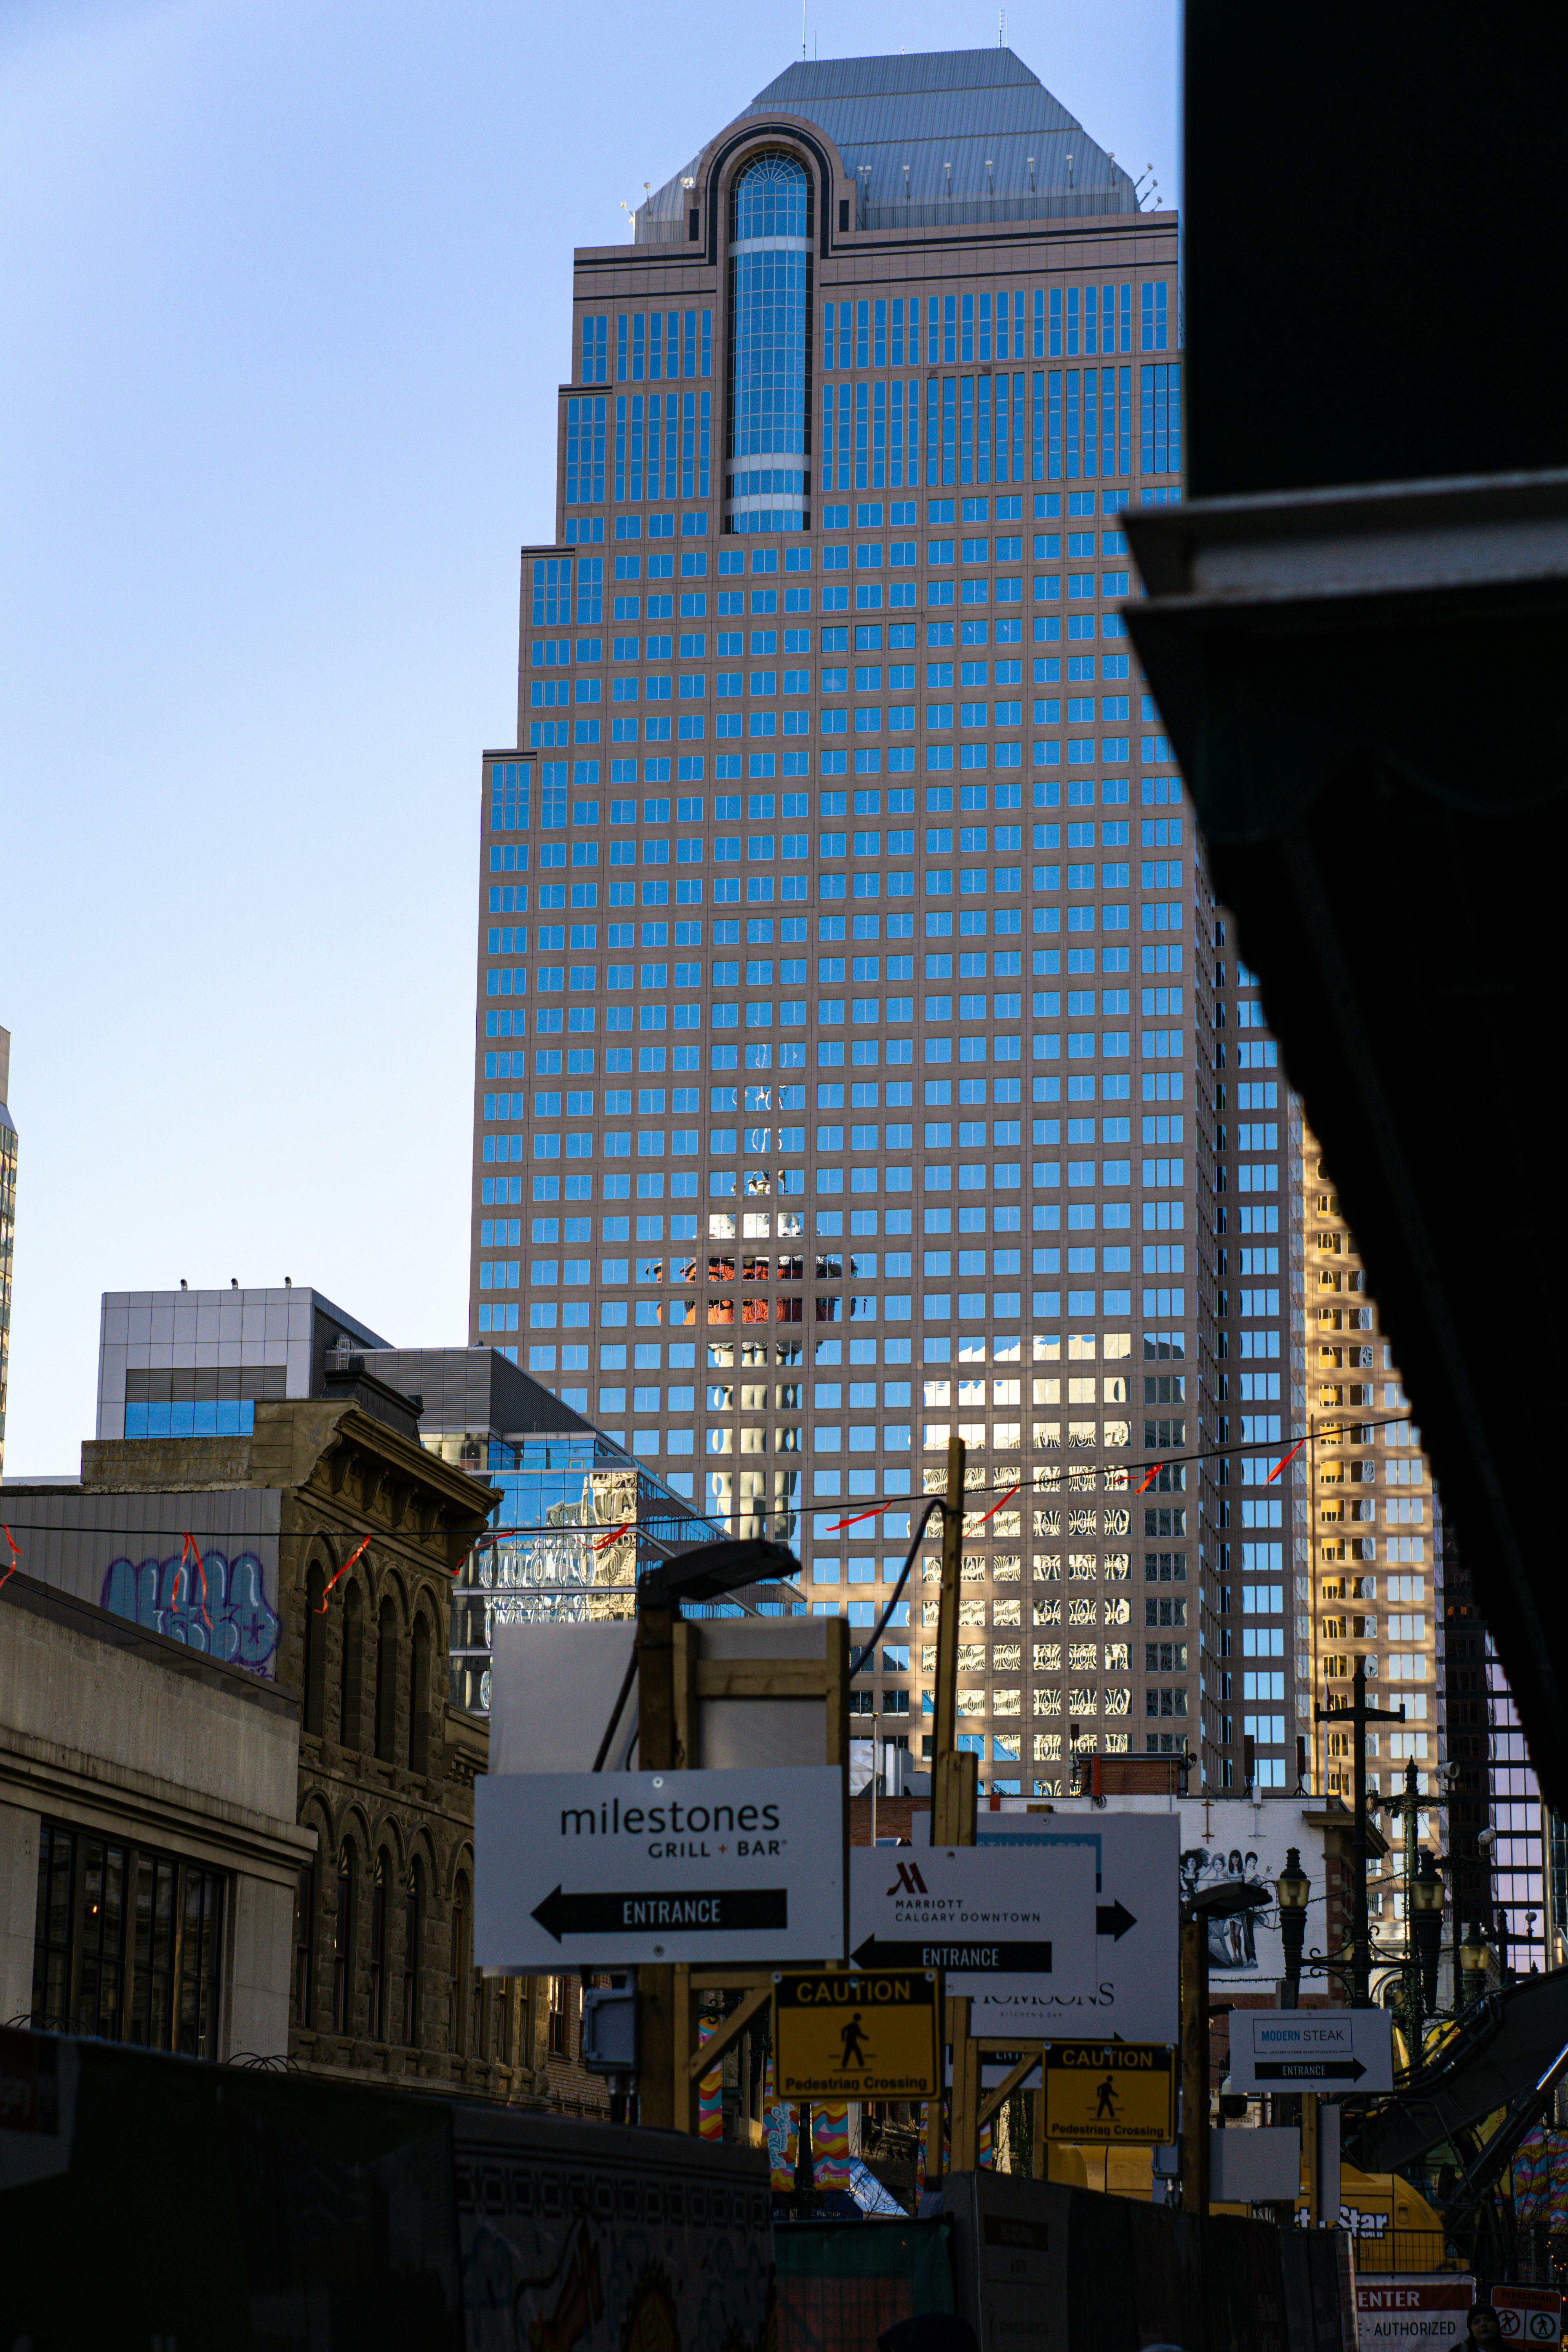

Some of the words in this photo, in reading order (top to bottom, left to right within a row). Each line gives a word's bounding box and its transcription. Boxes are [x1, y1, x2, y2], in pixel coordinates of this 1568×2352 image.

[561, 1798, 780, 1835] milestones
[648, 1842, 710, 1858] GRILL
[623, 1899, 720, 1924] ENTRANCE
[896, 1900, 963, 1909] MARRIOTT
[895, 1913, 955, 1922] CALGARY
[961, 1913, 1040, 1922] DOWNTOWN
[923, 1948, 999, 1966] ENTRANCE
[797, 1980, 910, 2002] CAUTION
[1261, 2030, 1300, 2041] MODERN
[1303, 2029, 1344, 2041] STEAK
[1062, 2050, 1153, 2068] CAUTION
[1283, 2065, 1325, 2076] ENTRANCE
[786, 2078, 859, 2092] Pedestrian
[864, 2076, 927, 2092] Crossing
[1052, 2123, 1111, 2136] Pedestrian
[1113, 2125, 1164, 2138] Crossing
[1358, 2291, 1420, 2307] ENTER
[1502, 2290, 1552, 2302] PEDESTRIAN
[1510, 2301, 1543, 2309] DETOUR
[1374, 2321, 1456, 2336] AUTHORIZED
